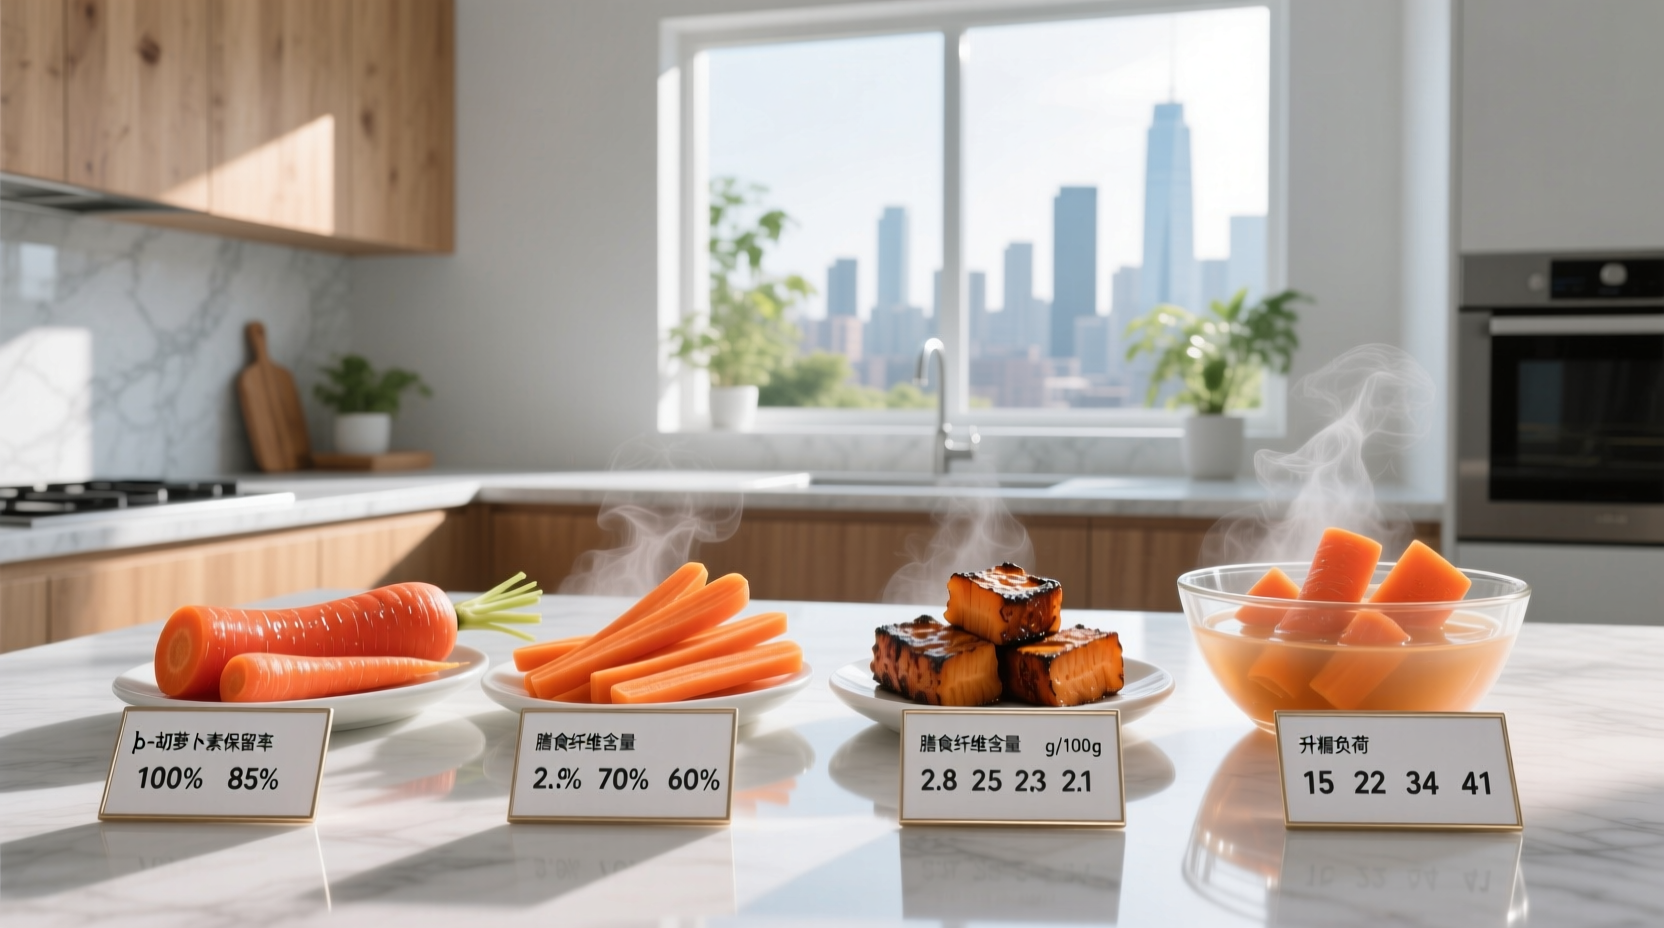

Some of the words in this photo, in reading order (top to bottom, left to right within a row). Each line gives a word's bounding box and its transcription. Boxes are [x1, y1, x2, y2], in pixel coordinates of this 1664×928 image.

[536, 732, 635, 751] 膳食纤维含量
[920, 734, 1021, 753] 膳食纤维含量
[1046, 737, 1101, 757] g/100g
[139, 766, 203, 789] 100%
[228, 767, 278, 790] 85%
[599, 768, 648, 790] 70%
[668, 768, 720, 791] 60%
[921, 769, 957, 791] 2.8
[972, 769, 1002, 791] 25
[1062, 770, 1090, 792] 2.1
[1304, 770, 1334, 794] 15
[1354, 770, 1386, 794] 22
[1406, 771, 1439, 795] 34
[1462, 771, 1491, 795] 41
